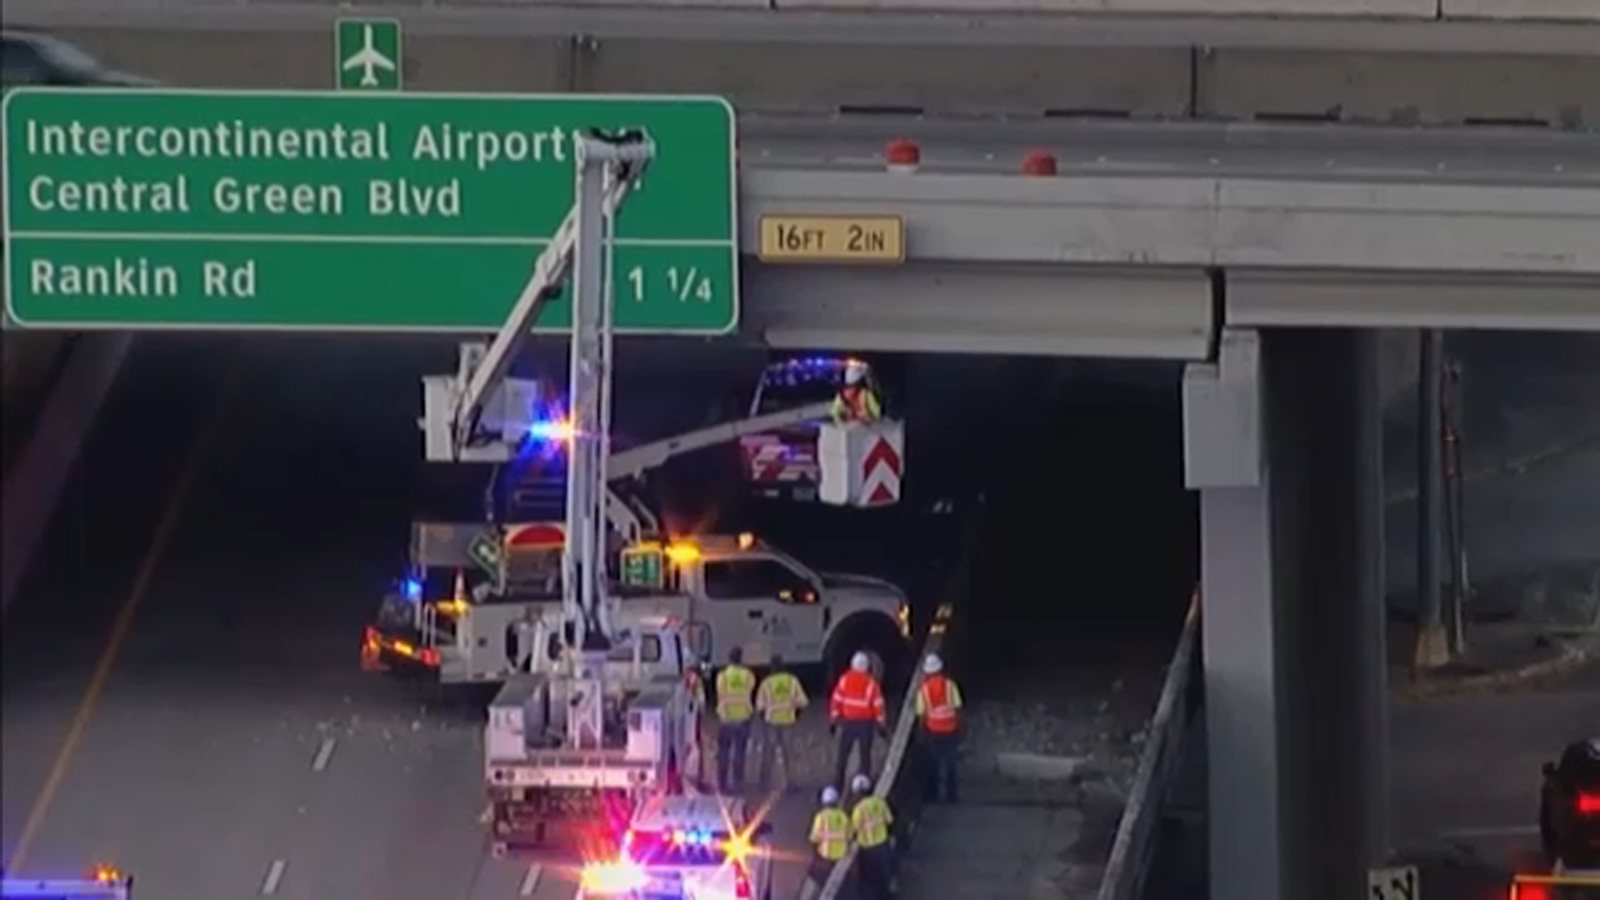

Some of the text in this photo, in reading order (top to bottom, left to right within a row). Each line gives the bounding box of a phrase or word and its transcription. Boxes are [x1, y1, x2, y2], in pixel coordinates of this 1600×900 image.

[26, 119, 566, 170] Intercontinental Airport
[30, 174, 461, 216] Central Green Blvd
[777, 223, 885, 252] 16FT 2IN
[31, 258, 178, 297] Rankin
[204, 260, 257, 297] Rd
[628, 265, 643, 301] 1
